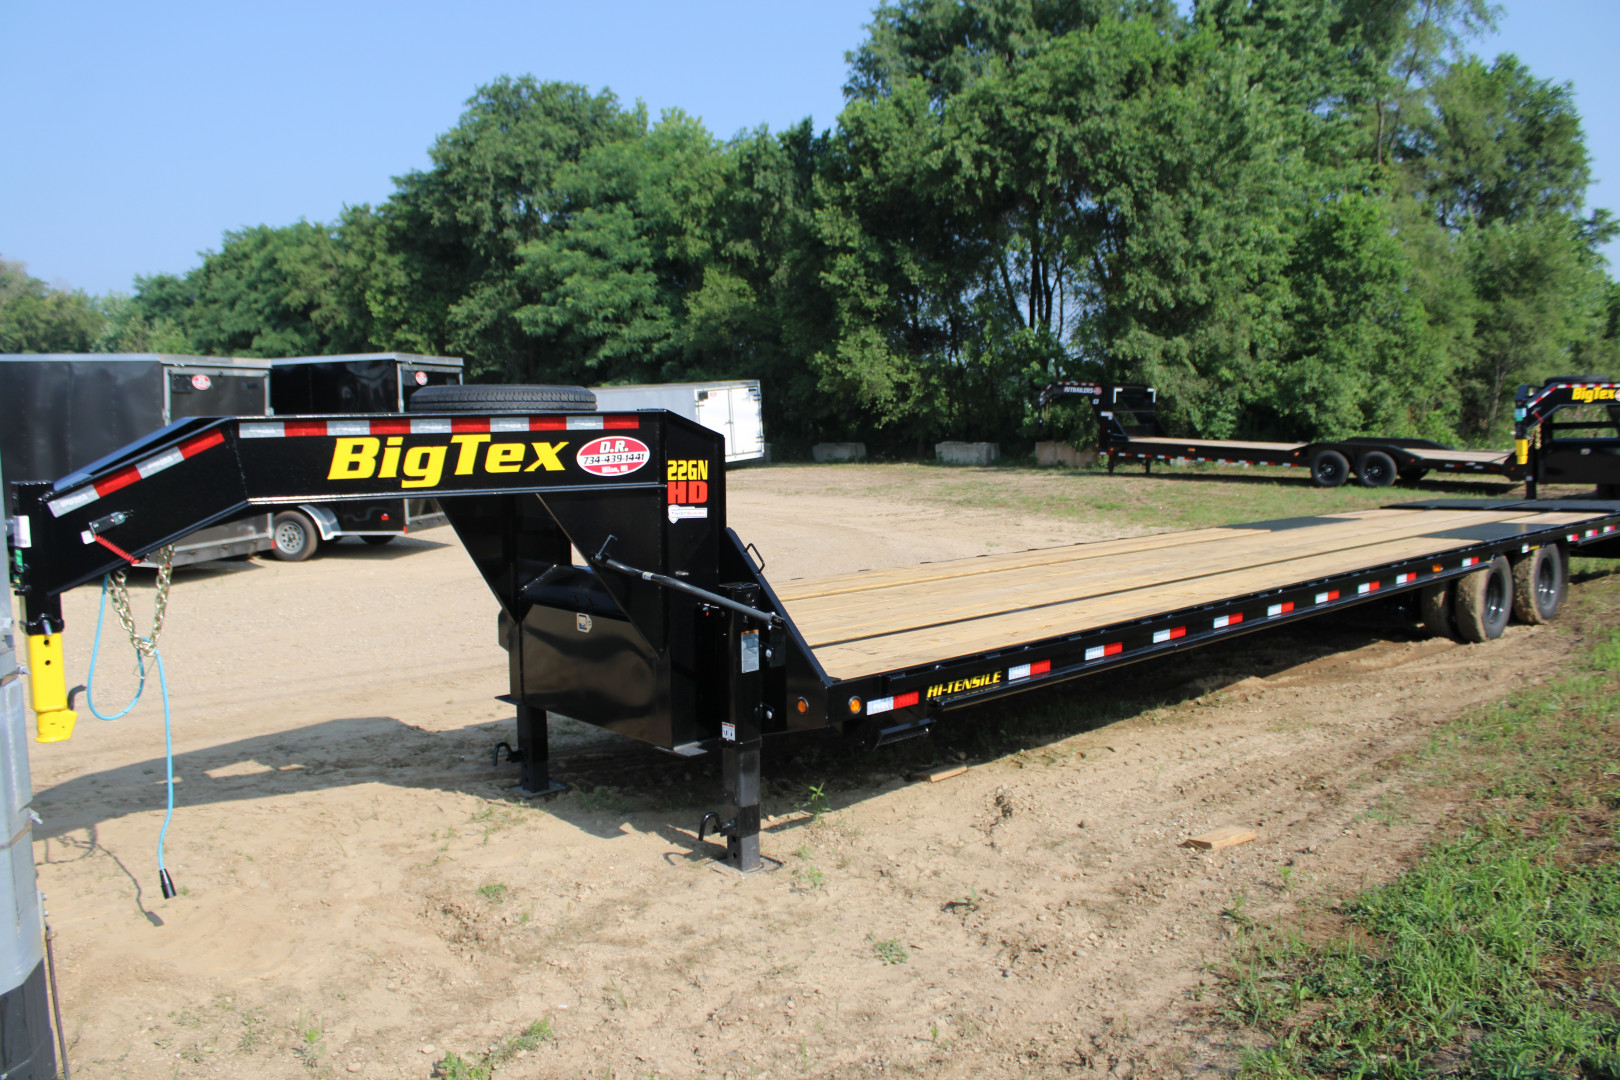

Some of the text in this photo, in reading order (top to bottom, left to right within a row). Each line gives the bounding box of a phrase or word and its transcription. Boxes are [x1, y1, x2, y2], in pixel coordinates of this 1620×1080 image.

[1572, 387, 1616, 403] BigTex
[599, 440, 629, 453] D.R.
[327, 434, 569, 488] BigTex
[583, 453, 645, 465] 734-439-1441
[667, 460, 708, 481] 22GN
[667, 480, 708, 504] HD
[927, 671, 1002, 698] HI-TENSILE
